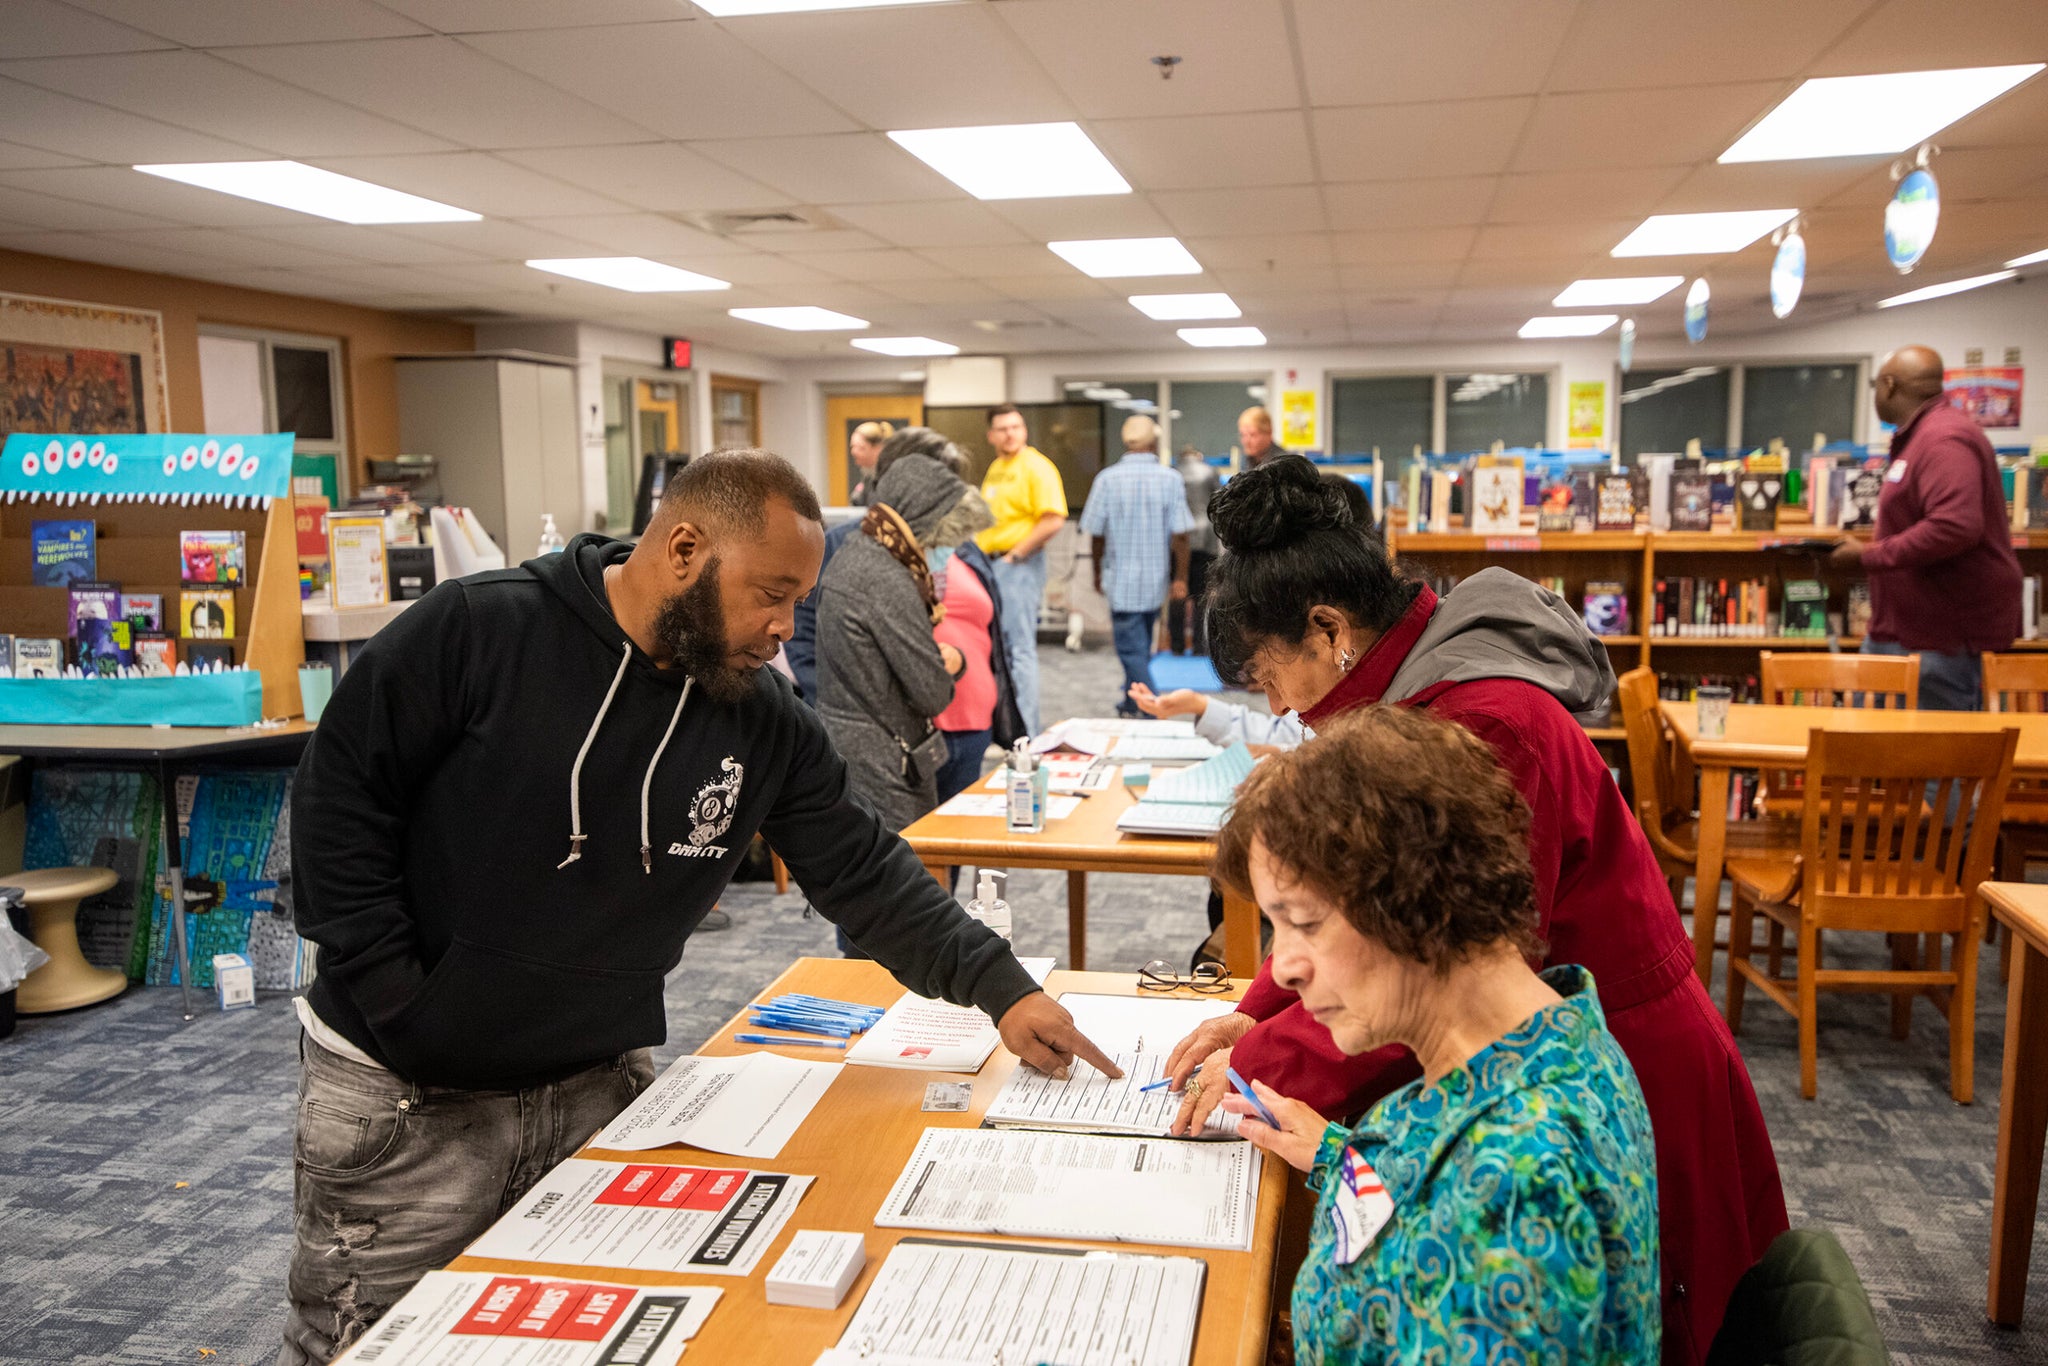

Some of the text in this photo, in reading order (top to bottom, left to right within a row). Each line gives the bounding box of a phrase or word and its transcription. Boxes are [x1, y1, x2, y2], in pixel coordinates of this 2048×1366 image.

[524, 1192, 563, 1218] GRACIAS
[484, 1285, 520, 1310] SIGN
[529, 1288, 568, 1318] SHOW
[575, 1293, 616, 1324] SAY IT
[473, 1311, 500, 1322] IT
[518, 1319, 546, 1330] IT
[613, 1305, 673, 1362] ATTENTION
